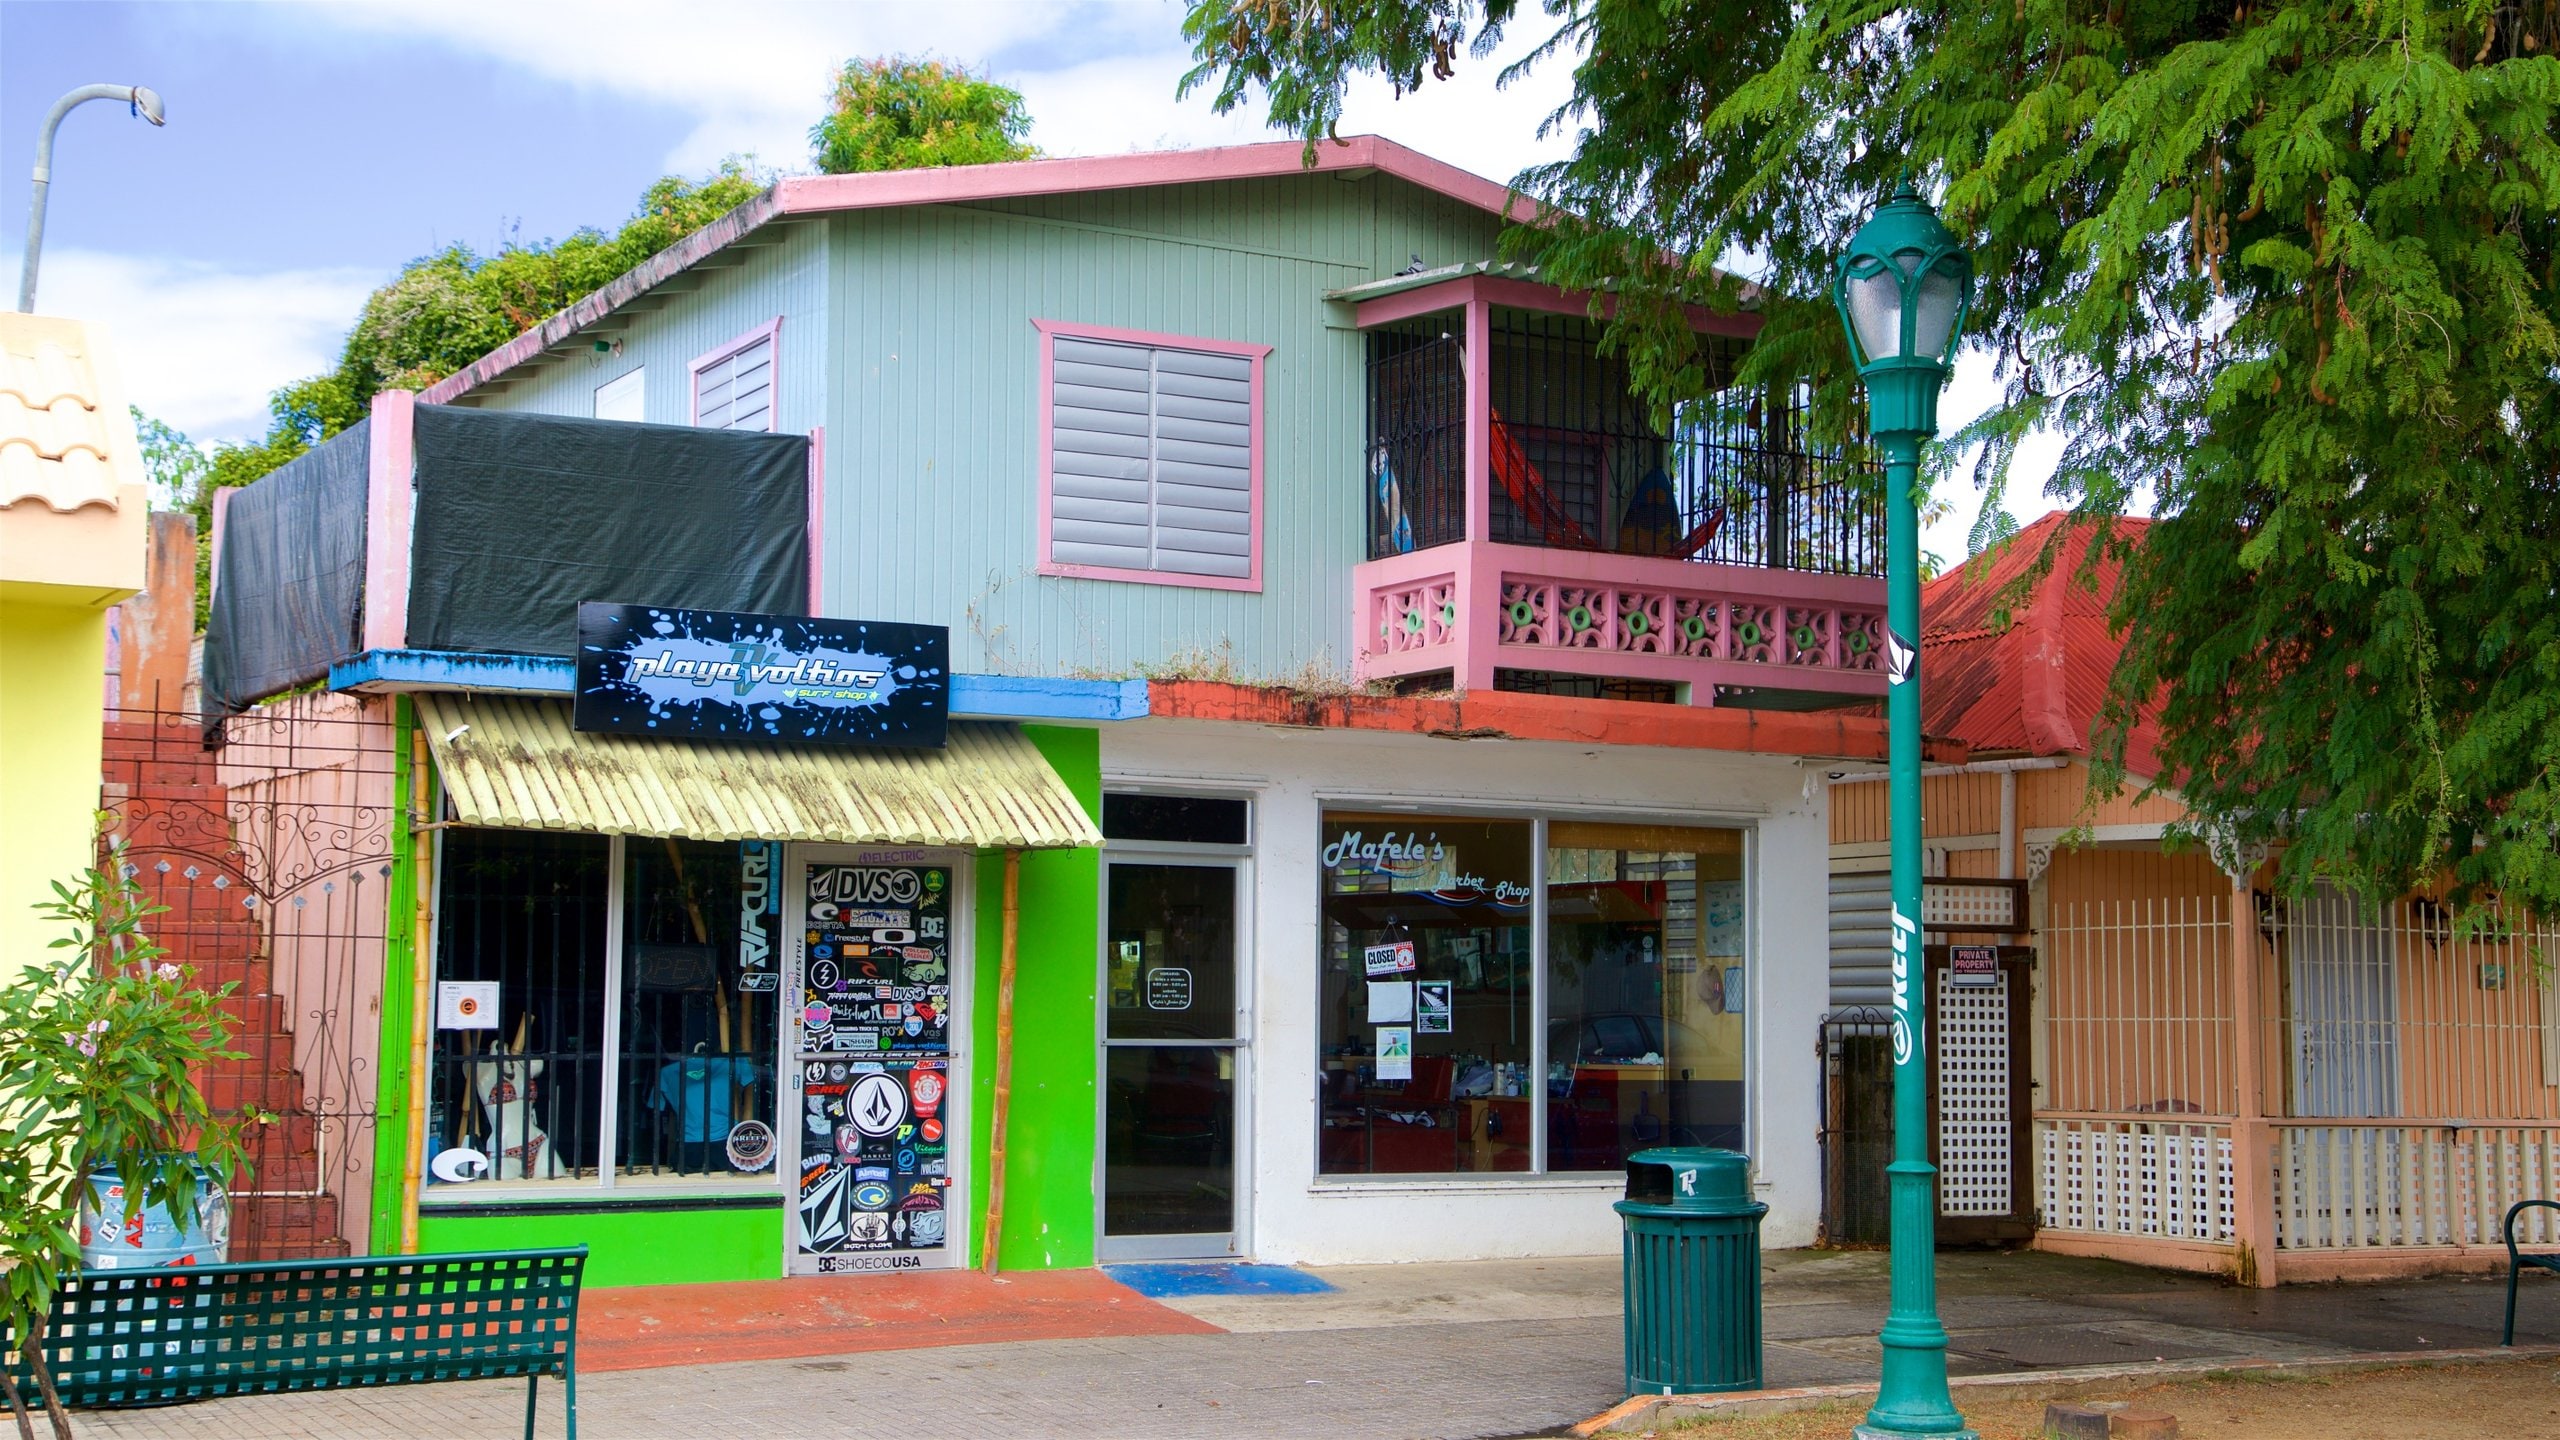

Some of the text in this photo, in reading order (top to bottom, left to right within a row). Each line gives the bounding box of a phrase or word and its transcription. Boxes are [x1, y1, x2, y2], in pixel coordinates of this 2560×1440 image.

[630, 650, 886, 689] playa voltios
[798, 688, 868, 702] surf shop
[872, 850, 925, 863] ELECTRIC
[1322, 831, 1445, 873] Mafele's
[837, 870, 891, 901] DVS
[1431, 871, 1531, 903] Barber Shop
[1368, 949, 1396, 965] CLOSED
[1891, 901, 1916, 1012] REEF
[1958, 950, 1990, 960] PRIVATE
[795, 937, 803, 989] FREESTYLE
[1955, 960, 1994, 969] PROPERTY
[893, 987, 914, 1000] DVS
[917, 1060, 947, 1069] AMSOIL
[820, 1085, 849, 1095] REEF
[801, 1153, 832, 1170] BLIND
[858, 1168, 887, 1178] Almost
[868, 1242, 893, 1250] GLOVE
